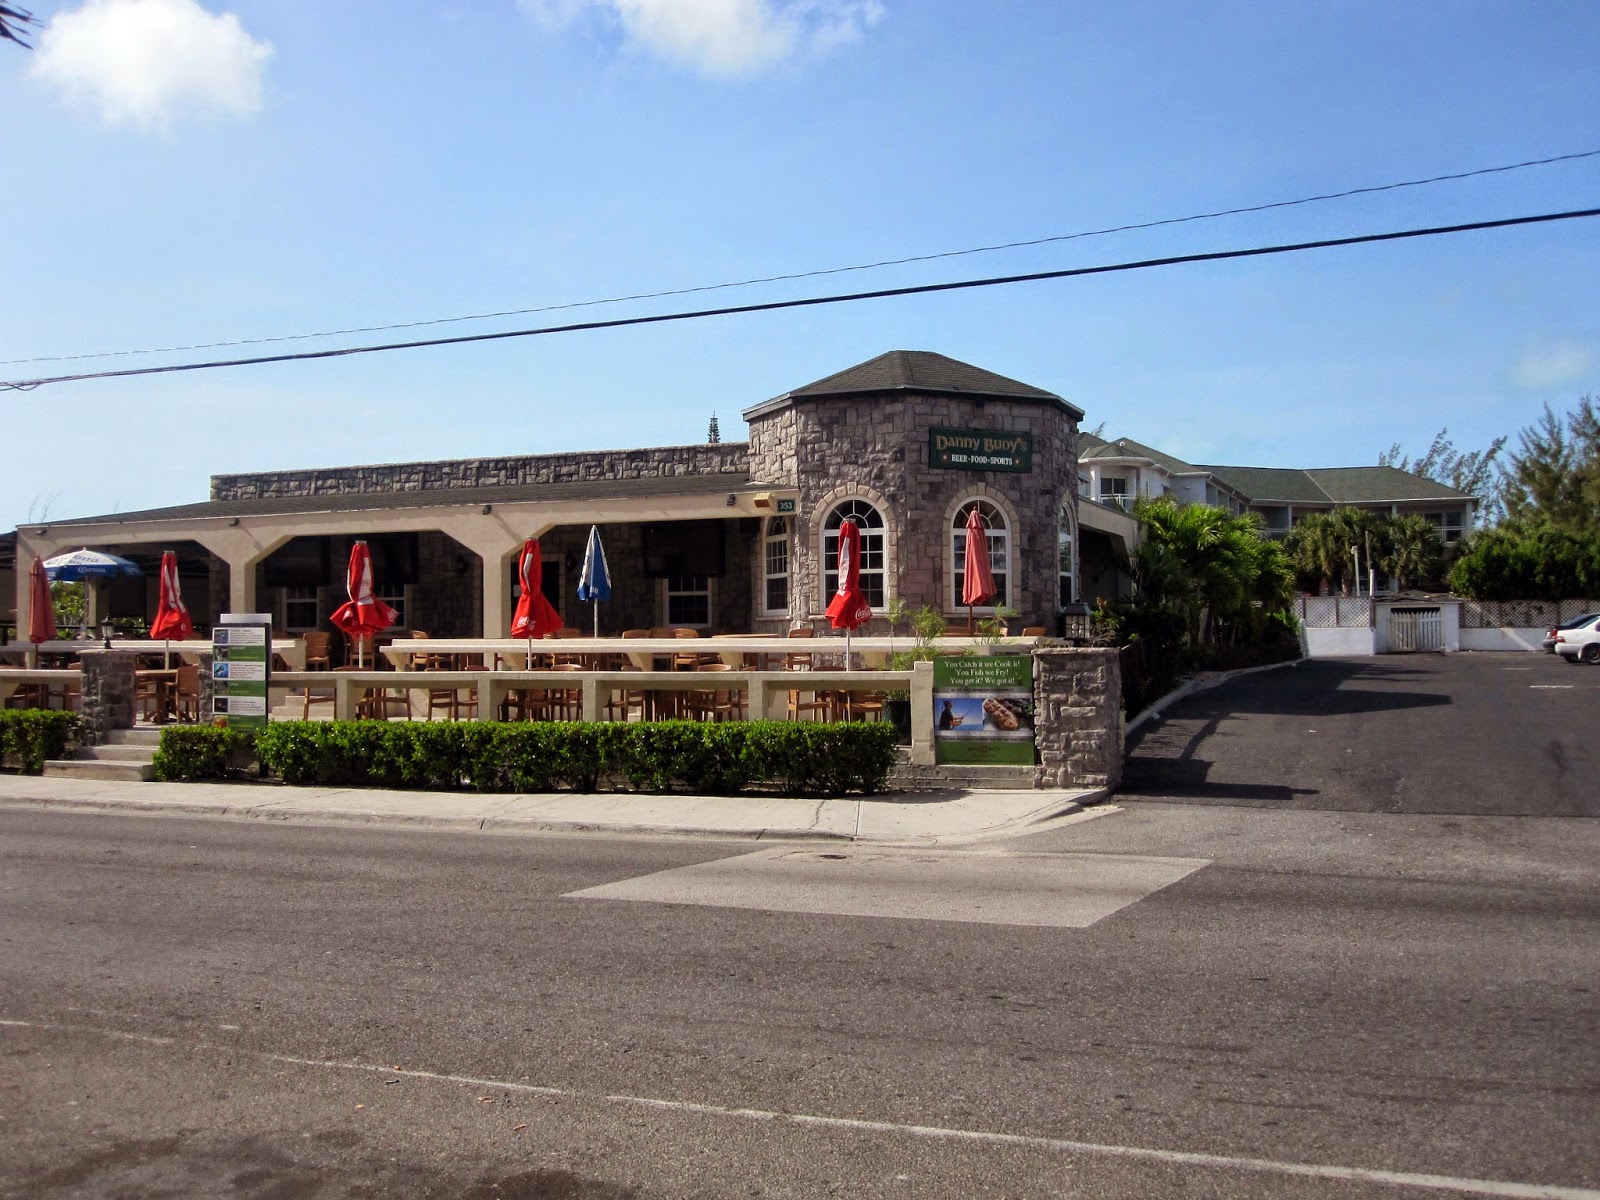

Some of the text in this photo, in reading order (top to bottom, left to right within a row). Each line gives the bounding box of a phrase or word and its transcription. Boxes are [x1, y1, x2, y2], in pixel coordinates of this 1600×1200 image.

[935, 435, 1027, 453] Danny Buoy's
[951, 454, 1013, 466] BEER FOOD SPORTS
[970, 668, 984, 676] Fish
[995, 668, 1009, 677] Fry!
[964, 678, 974, 686] get
[996, 678, 1007, 686] got
